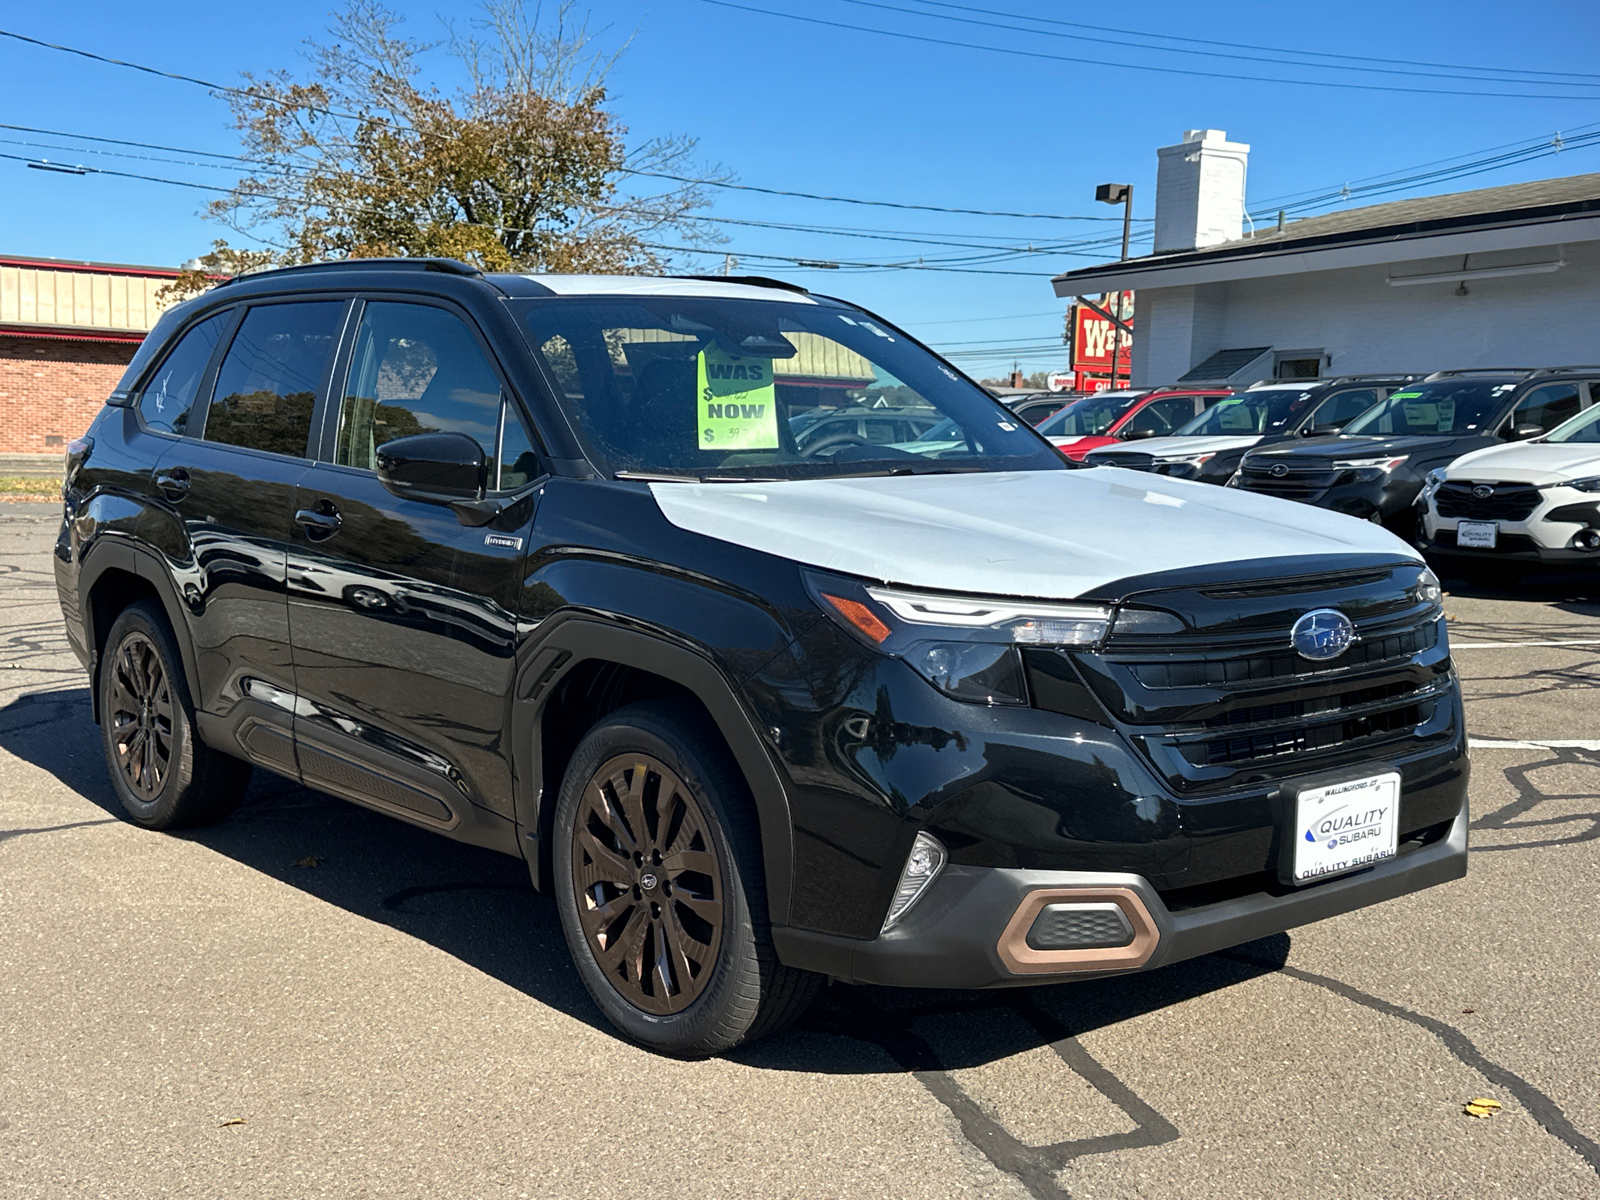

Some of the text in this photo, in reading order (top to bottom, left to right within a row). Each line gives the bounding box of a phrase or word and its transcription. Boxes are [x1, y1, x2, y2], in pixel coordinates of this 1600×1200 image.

[708, 363, 763, 380] WAS
[703, 386, 713, 402] $
[708, 403, 765, 419] NOW
[704, 428, 715, 443] $
[1320, 807, 1388, 834] QUALITY
[1338, 827, 1382, 845] SUBARU
[1302, 848, 1396, 879] QUALITY SUBARU
